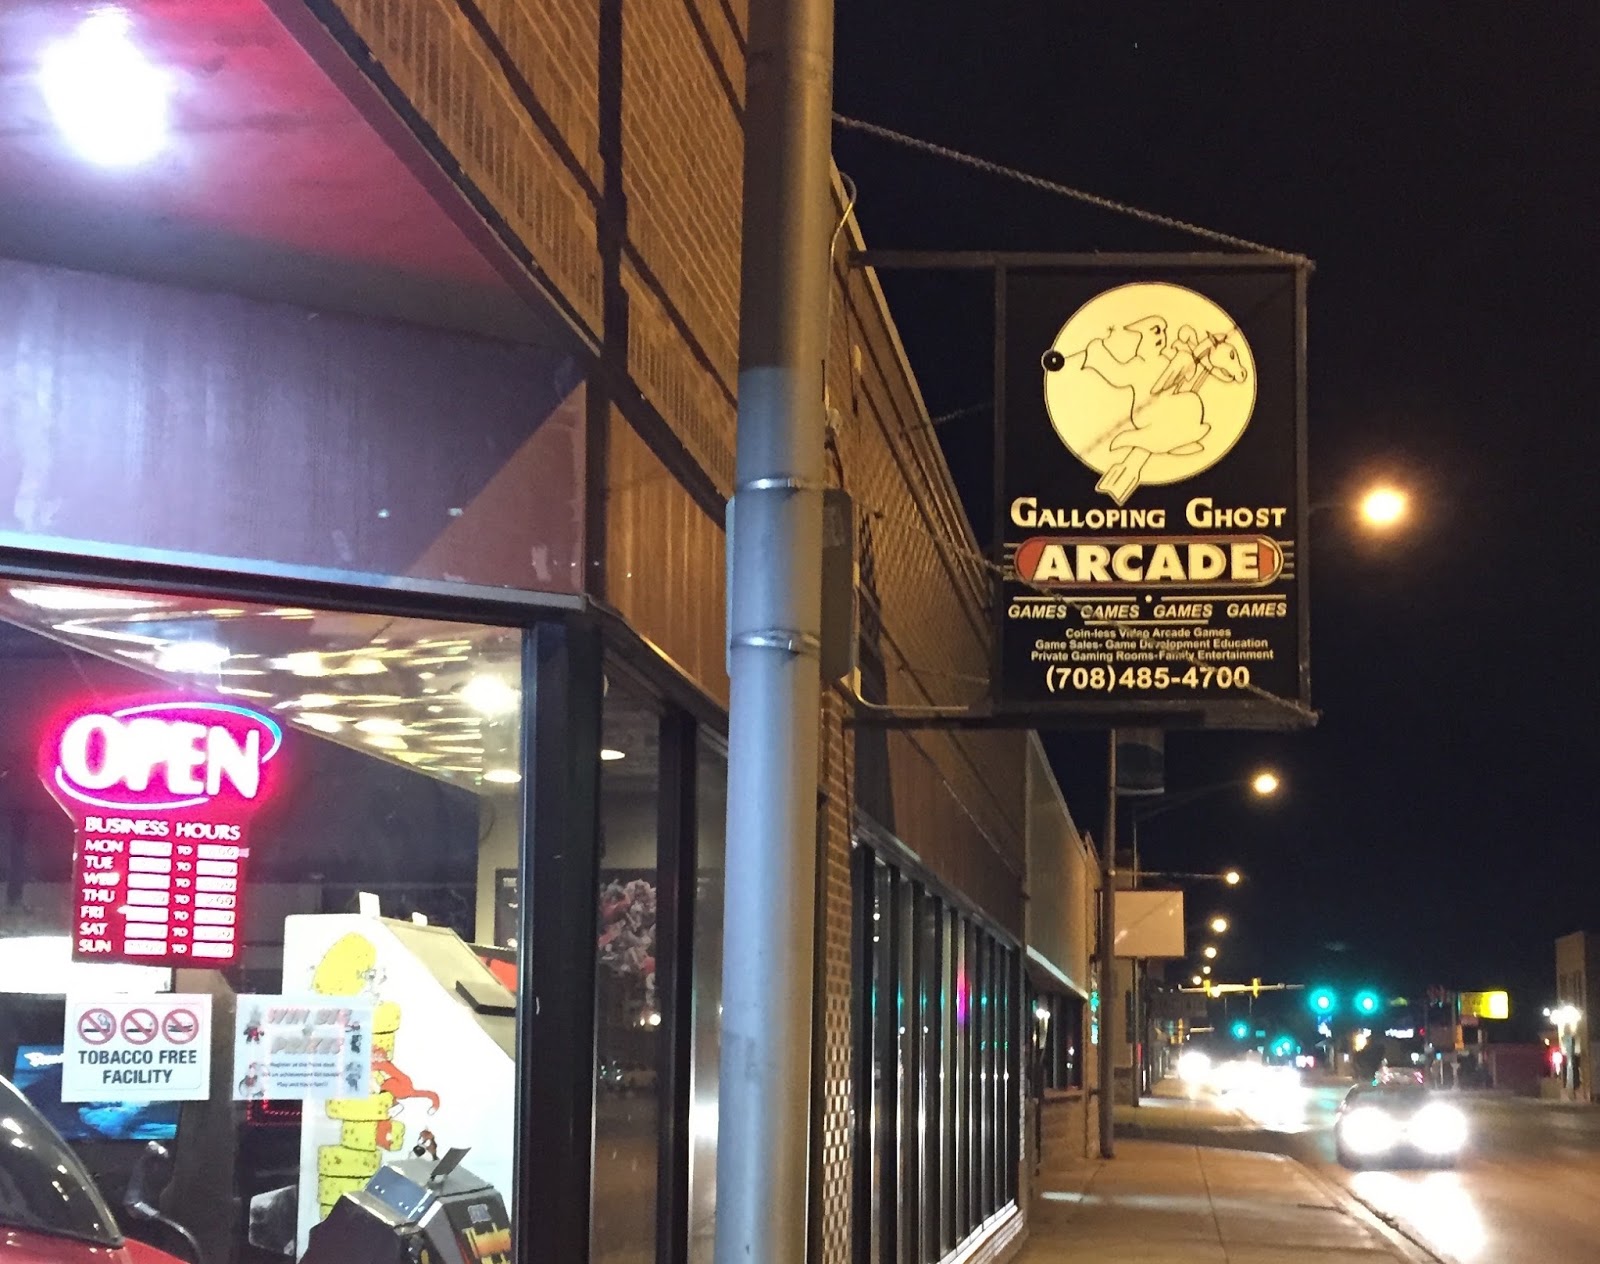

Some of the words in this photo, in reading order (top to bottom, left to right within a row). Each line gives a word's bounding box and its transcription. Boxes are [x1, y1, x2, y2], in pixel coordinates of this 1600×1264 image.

[1010, 497, 1166, 529] GALLOPING
[1185, 497, 1287, 529] GHOST
[1031, 542, 1259, 582] ARCADE
[1008, 604, 1067, 619] GAMES
[1080, 604, 1140, 619] GAMES
[1153, 603, 1213, 619] GAMES
[1226, 602, 1287, 618] GAMES
[1152, 627, 1191, 638] Arcade
[1193, 626, 1232, 638] Games
[1035, 639, 1067, 650] Game
[1105, 639, 1137, 650] Game
[1213, 638, 1269, 649] Education
[1031, 650, 1069, 662] Private
[1071, 650, 1113, 663] Gaming
[1197, 649, 1274, 661] Entertainment
[60, 714, 260, 799] OPEN
[85, 816, 170, 836] BUSINESS
[175, 822, 241, 841] HOURS
[84, 839, 124, 853] MON
[176, 845, 193, 856] TO
[83, 855, 114, 870] TUE
[176, 861, 192, 872] TO
[174, 877, 191, 888] TO
[82, 888, 116, 903] THU
[173, 894, 190, 905] TO
[80, 905, 105, 919] FRI
[173, 910, 190, 921] TO
[79, 922, 109, 936] SAT
[172, 927, 189, 938] TO
[78, 939, 112, 953] SUN
[171, 943, 188, 954] TO
[78, 1050, 153, 1065] TOBACCO
[159, 1050, 197, 1064] FREE
[102, 1069, 173, 1084] FACILITY
